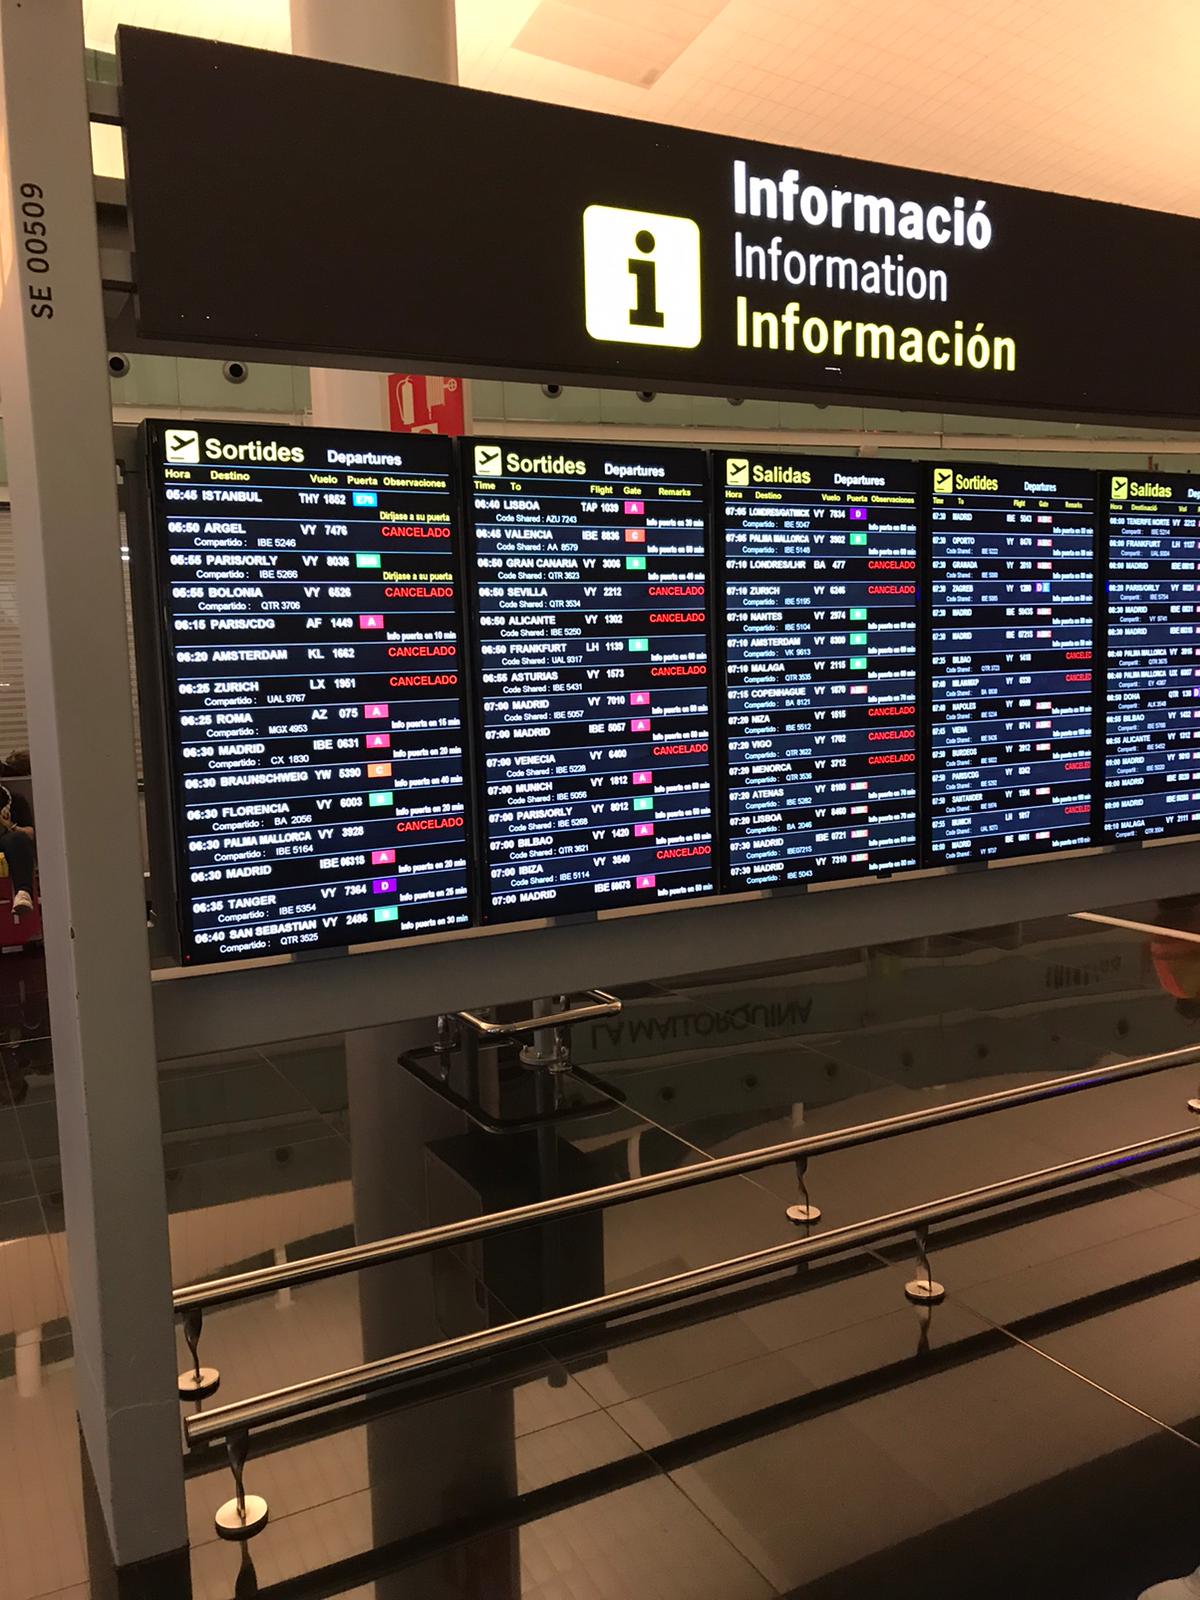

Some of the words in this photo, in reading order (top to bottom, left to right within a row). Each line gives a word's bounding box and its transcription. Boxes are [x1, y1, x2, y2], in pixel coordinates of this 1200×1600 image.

[733, 160, 992, 250] Informació
[20, 182, 49, 273] 00509
[735, 232, 948, 302] Information
[29, 285, 53, 319] SE
[737, 296, 1016, 372] Información
[206, 439, 304, 462] Sortides
[328, 450, 402, 466] Departures
[507, 454, 586, 475] Sortides
[605, 463, 665, 477] Departures
[165, 470, 190, 480] Hora
[210, 470, 250, 482] Destino
[310, 474, 338, 485] Vuelo
[347, 476, 378, 486] Puerta
[383, 477, 446, 488] Observaciones
[753, 465, 811, 484] Salidas
[834, 474, 885, 486] Departures
[955, 474, 998, 491] Sortides
[1024, 481, 1056, 492] Departures
[474, 481, 495, 490] Time
[510, 482, 521, 490] To
[590, 485, 612, 495] Flight
[624, 487, 641, 495] Gate
[659, 488, 691, 497] Remarks
[1130, 483, 1172, 498] Salidas
[166, 490, 198, 501] 05:45
[202, 490, 262, 502] ISTANBUL
[299, 494, 318, 504] THY
[324, 494, 346, 505] 1852
[504, 500, 540, 510] LISBOA
[581, 502, 596, 512] TAP
[631, 504, 637, 512] A
[416, 513, 425, 521] su
[427, 514, 450, 523] puerta
[168, 523, 200, 533] 05:50
[204, 524, 246, 534] ARGEL
[301, 525, 316, 536] VY
[382, 526, 450, 538] CANCELADO
[505, 530, 553, 539] VALENCIA
[582, 531, 598, 540] IBE
[258, 538, 272, 548] IBE
[274, 538, 296, 548] 5246
[170, 556, 202, 566] 05:55
[206, 556, 277, 566] PARIS/ORLY
[303, 556, 318, 566] VY
[507, 559, 534, 568] GRAN
[536, 559, 578, 568] CANARIA
[583, 559, 596, 568] VY
[868, 561, 915, 569] CANCELADO
[260, 570, 274, 578] IBE
[276, 570, 298, 578] 5266
[173, 588, 204, 598] 05:55
[209, 588, 262, 598] BOLONIA
[304, 587, 320, 598] VY
[385, 588, 453, 598] CANCELADO
[508, 588, 547, 596] SEVILLA
[584, 587, 596, 596] VY
[603, 587, 622, 596] 2212
[649, 587, 704, 596] CANCELADO
[750, 586, 780, 595] ZURICH
[262, 602, 280, 610] QTR
[280, 601, 300, 610] 3706
[175, 620, 206, 630] 06:15
[210, 619, 275, 630] PARIS/CDG
[306, 618, 322, 628] AF
[330, 618, 353, 628] 1449
[368, 618, 376, 626] A
[509, 616, 556, 625] ALICANTE
[585, 615, 597, 624] VY
[650, 613, 705, 622] CANCELADO
[177, 652, 208, 662] 06:20
[213, 650, 287, 661] AMSTERDAM
[308, 649, 324, 660] KL
[388, 646, 456, 657] CANCELADO
[510, 643, 567, 653] FRANKFURT
[586, 643, 599, 652] LH
[511, 671, 558, 682] ASTURIAS
[587, 670, 600, 679] VY
[652, 666, 706, 676] CANCELADO
[179, 684, 210, 694] 06:25
[214, 682, 258, 693] ZURICH
[310, 679, 325, 690] LX
[390, 675, 458, 686] CANCELADO
[181, 716, 212, 726] 06:25
[216, 713, 252, 724] ROMA
[312, 710, 327, 720] AZ
[340, 708, 358, 718] 075
[372, 708, 380, 716] A
[183, 748, 214, 758] 06:30
[218, 744, 264, 756] MADRID
[314, 740, 333, 750] IBE
[337, 738, 359, 748] 0631
[374, 737, 382, 746] A
[752, 740, 772, 749] VIGO
[271, 756, 284, 764] CX
[289, 754, 309, 764] 1830
[515, 755, 555, 765] VENECIA
[654, 744, 708, 755] CANCELADO
[752, 763, 792, 773] MENORCA
[185, 778, 216, 789] 06:30
[220, 772, 308, 786] BRAUNSCHWEIG
[316, 770, 331, 780] YW
[339, 768, 361, 778] 5390
[753, 789, 784, 798] ATENAS
[187, 810, 218, 820] 06:30
[222, 804, 289, 817] FLORENCIA
[317, 800, 332, 810] VY
[340, 797, 362, 808] 6003
[517, 807, 572, 820] PARIS/ORLY
[274, 817, 286, 826] BA
[292, 815, 312, 824] 2056
[190, 840, 220, 851] 06:30
[224, 835, 258, 849] PALMA
[260, 832, 311, 846] MALLORCA
[318, 830, 334, 840] VY
[342, 826, 364, 837] 3928
[397, 818, 464, 832] CANCELADO
[490, 841, 514, 850] 07:00
[518, 836, 553, 847] BILBAO
[519, 864, 543, 875] IBIZA
[656, 846, 711, 859] CANCELADO
[191, 871, 222, 882] 06:30
[226, 866, 272, 878] MADRID
[320, 858, 339, 869] IBE
[193, 902, 223, 912] 06:35
[228, 896, 276, 910] TANGER
[321, 888, 336, 898] VY
[345, 886, 366, 896] 7364
[381, 882, 389, 890] D
[520, 890, 556, 902] MADRID
[195, 932, 225, 944] 06:40
[230, 928, 252, 940] SAN
[256, 920, 316, 936] SEBASTIAN
[322, 918, 338, 928] VY
[280, 936, 298, 945] QTR
[300, 934, 318, 944] 3525
